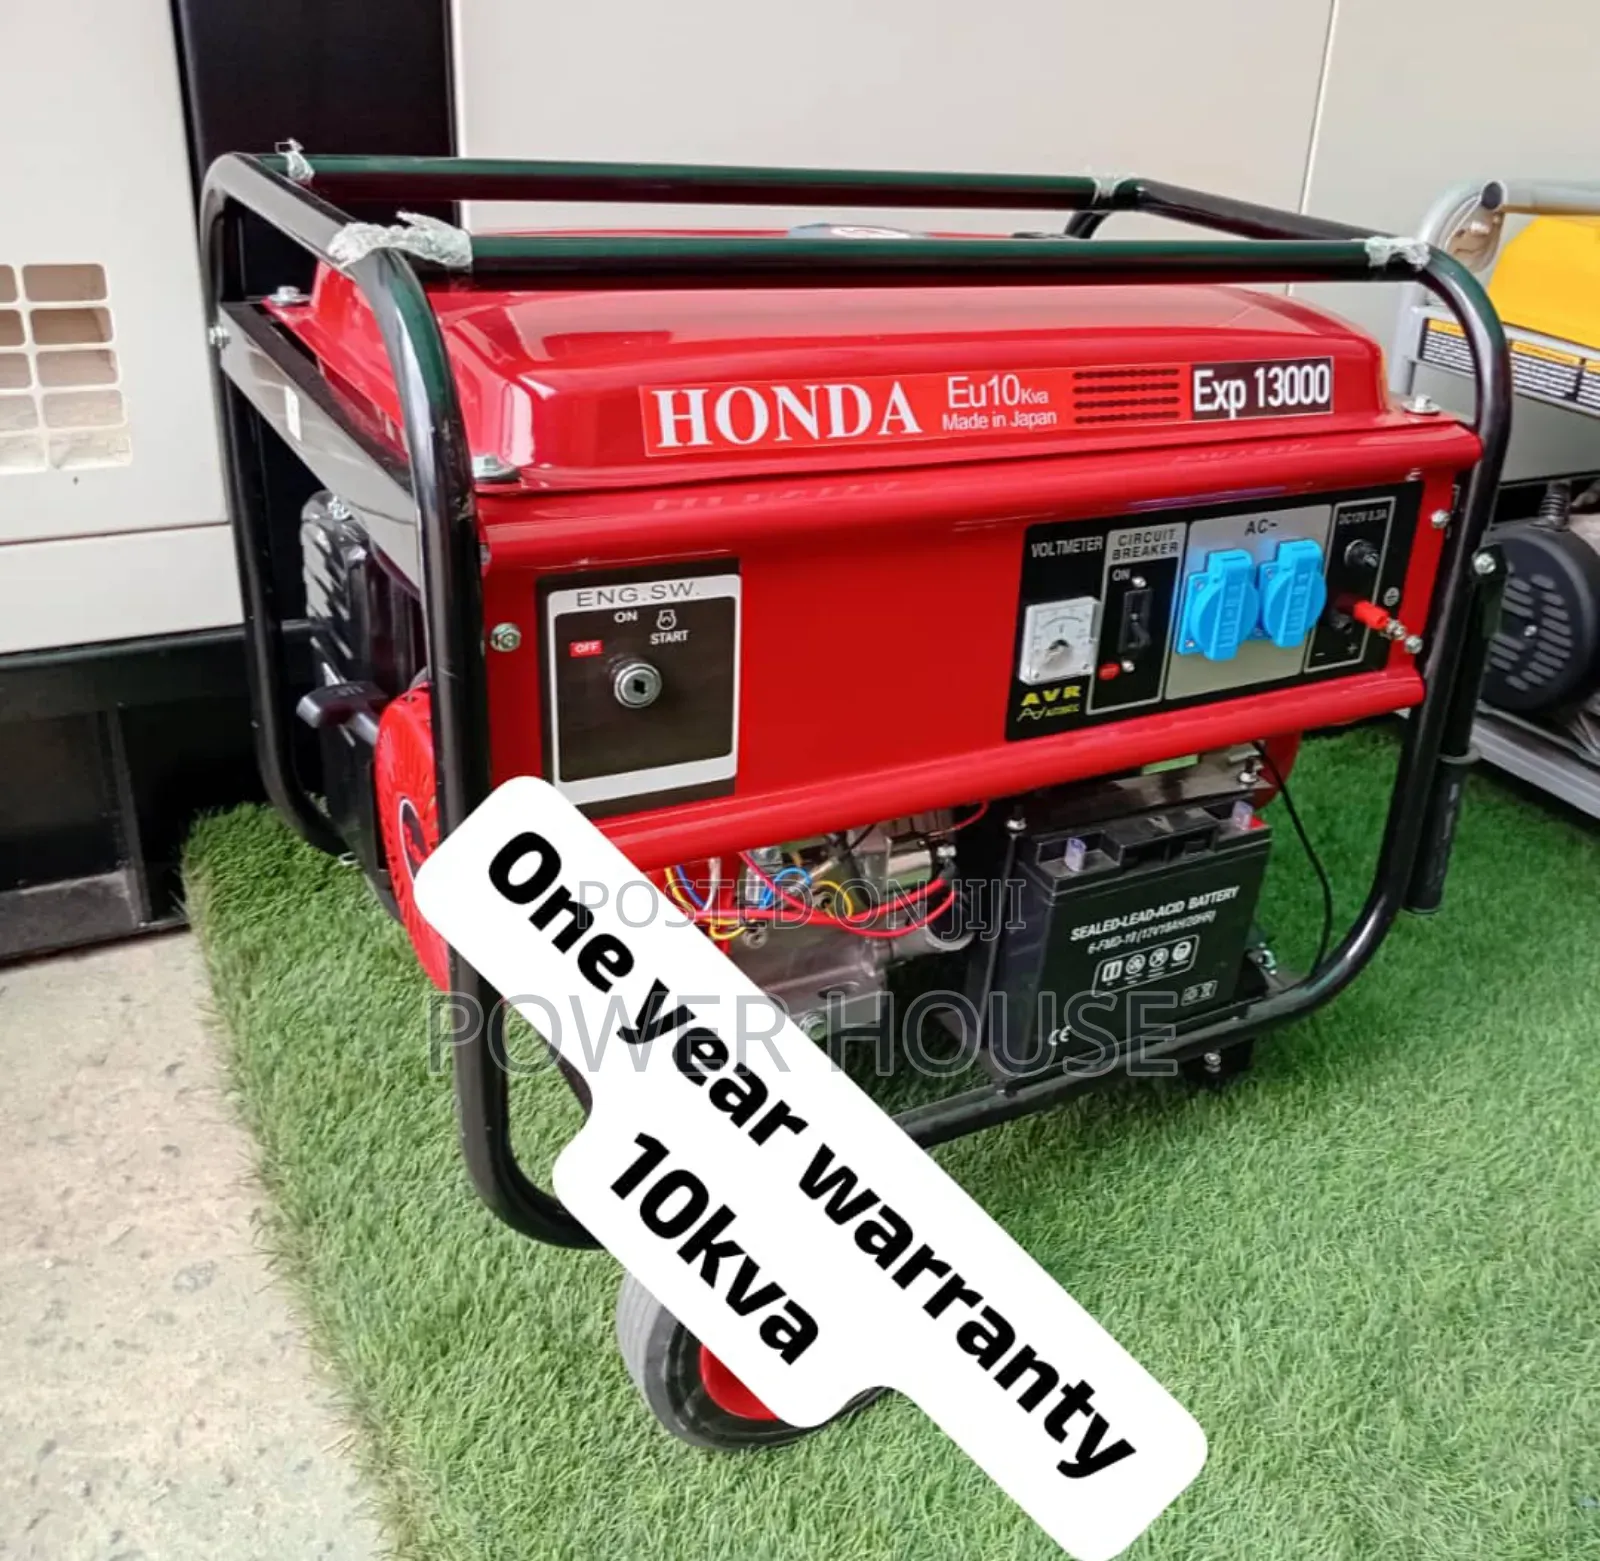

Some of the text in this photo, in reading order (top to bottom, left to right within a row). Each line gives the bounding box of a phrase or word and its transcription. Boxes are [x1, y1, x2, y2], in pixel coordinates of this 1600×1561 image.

[1193, 363, 1330, 420] Exp 13000
[651, 379, 923, 448] HONDA
[942, 410, 1058, 431] Made in Japan
[1031, 535, 1104, 558] VOLTMETER
[1118, 528, 1177, 547] CIRCUIT
[1111, 541, 1179, 561] BREAKER
[1112, 568, 1131, 582] ON
[613, 610, 639, 623] ON
[650, 629, 689, 645] START
[574, 641, 600, 654] OFF
[1020, 685, 1082, 707] AVR
[1187, 885, 1241, 910] BATTERY
